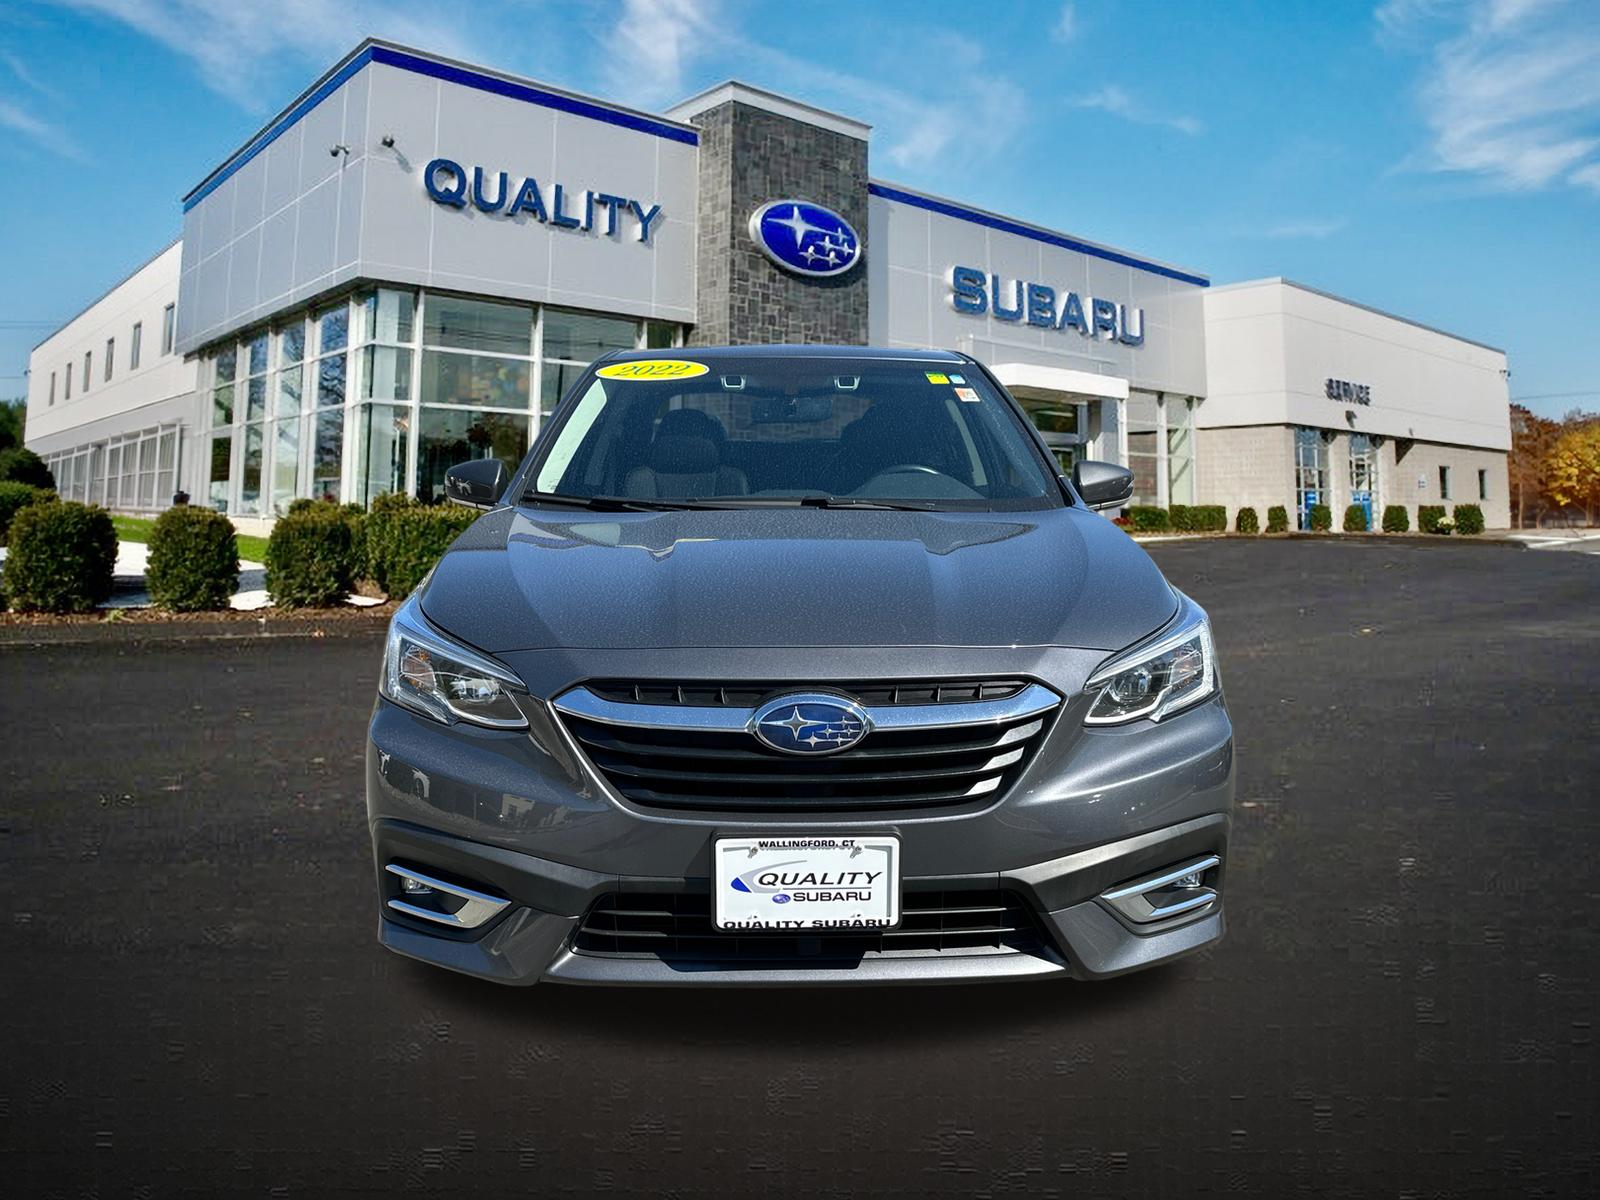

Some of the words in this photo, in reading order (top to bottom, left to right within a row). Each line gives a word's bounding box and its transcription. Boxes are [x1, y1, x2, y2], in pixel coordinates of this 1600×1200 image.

[424, 158, 661, 243] QUALITY
[952, 265, 1145, 346] SUBARU
[613, 364, 691, 376] 2022
[1325, 378, 1370, 406] SERVICE
[758, 871, 882, 886] QUALITY
[793, 891, 872, 902] SUBARU
[723, 920, 805, 929] QUALITY
[812, 919, 891, 929] SUBARU
